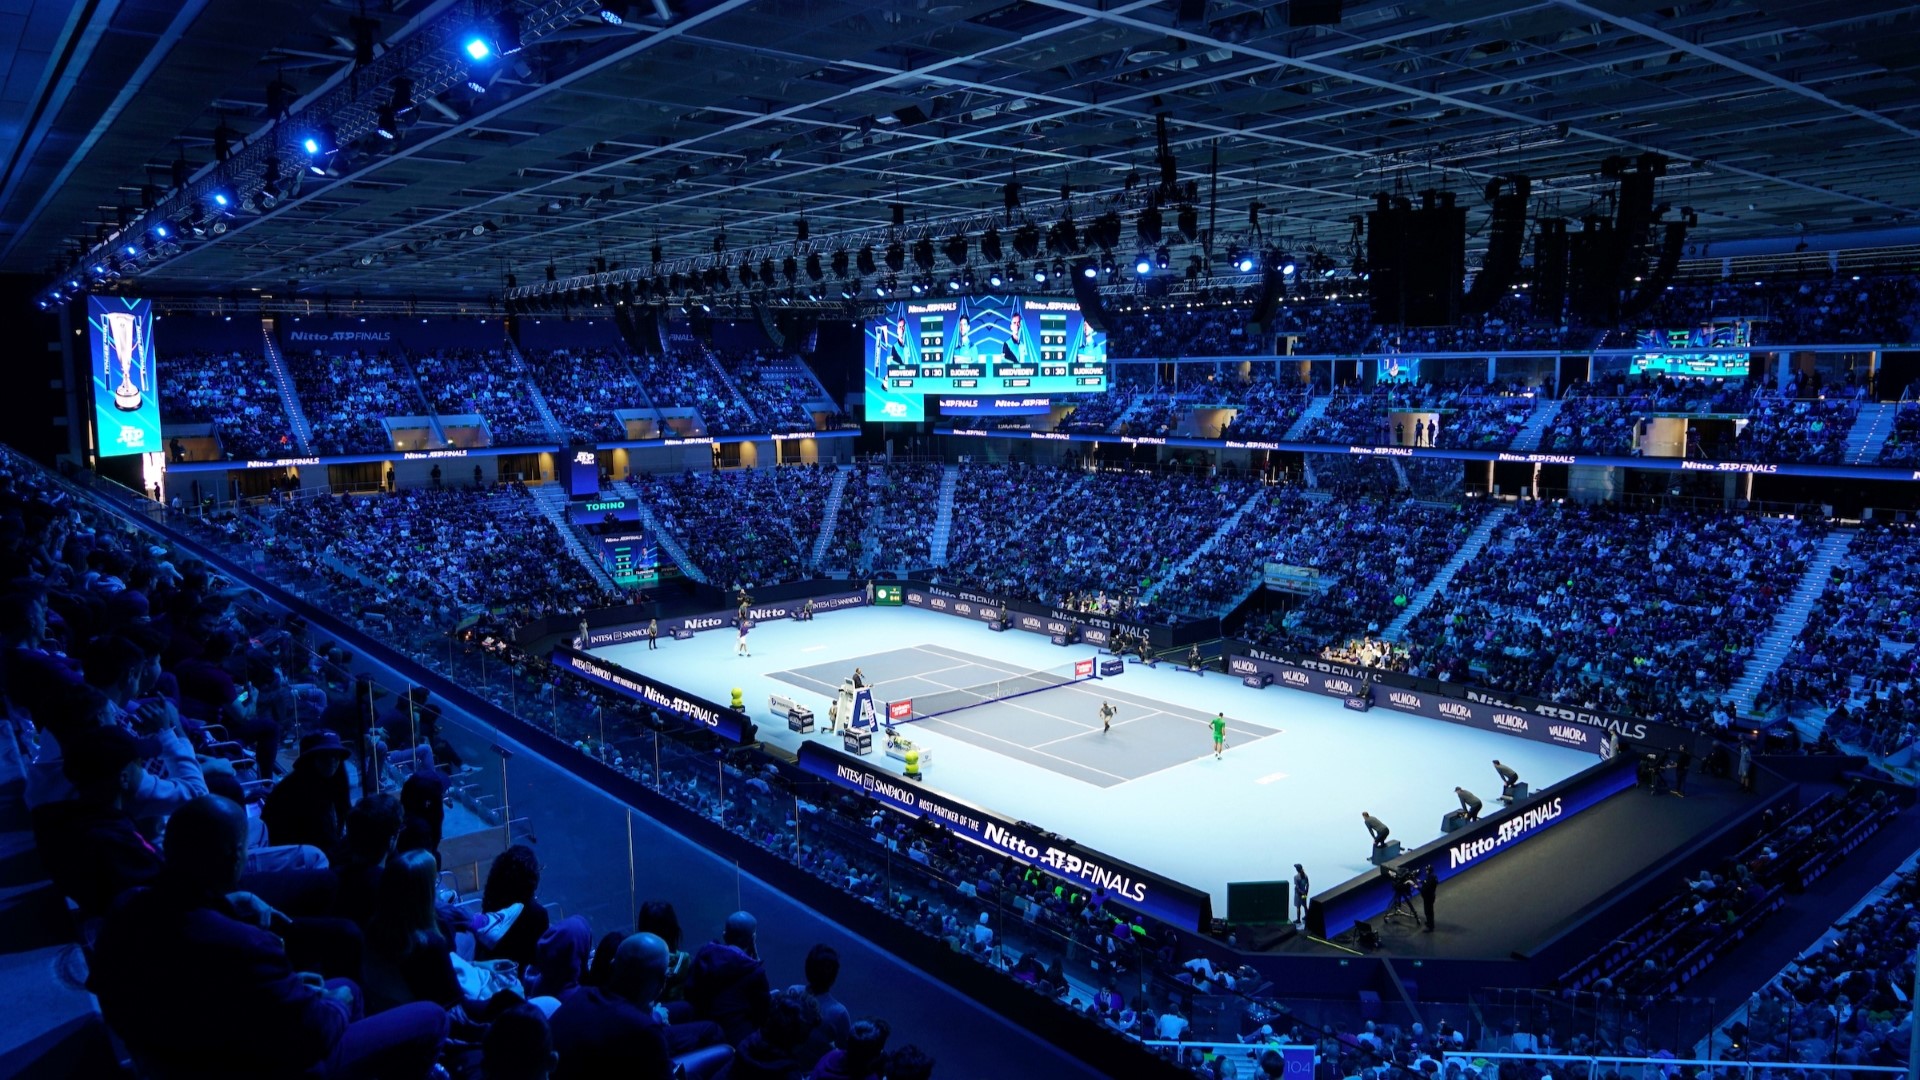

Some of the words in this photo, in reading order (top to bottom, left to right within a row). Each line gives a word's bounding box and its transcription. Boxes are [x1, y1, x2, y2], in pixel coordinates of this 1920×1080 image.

[290, 331, 328, 340] Nitto
[1682, 461, 1714, 469] Nitto
[586, 502, 625, 511] TORINO
[977, 596, 998, 606] FINAL
[750, 609, 785, 619] Nitto
[684, 618, 722, 629] Nitto
[591, 635, 612, 643] INTESA
[1233, 660, 1257, 673] VALMORA
[1282, 671, 1309, 684] VALMORA
[1324, 679, 1353, 693] VALMORA
[644, 685, 670, 706] Nitto
[689, 705, 719, 726] FINALS
[1390, 692, 1421, 708] VALMORA
[1438, 703, 1471, 718] VALMORA
[1493, 714, 1528, 730] VALMORA
[1577, 713, 1646, 740] FINALS
[1549, 726, 1587, 742] VALMORA
[837, 764, 862, 785] INTESA
[874, 780, 914, 806] SANPAOLO
[919, 799, 933, 812] HOST
[934, 803, 958, 822] PARTNER
[960, 817, 967, 825] OF
[967, 819, 979, 831] THE
[984, 822, 1039, 858] Nitto
[1039, 846, 1082, 873] ATP
[1081, 862, 1146, 902] FINALS
[1450, 837, 1494, 868] Nitto
[1523, 797, 1561, 831] FINALS
[1287, 1061, 1311, 1073] 104
